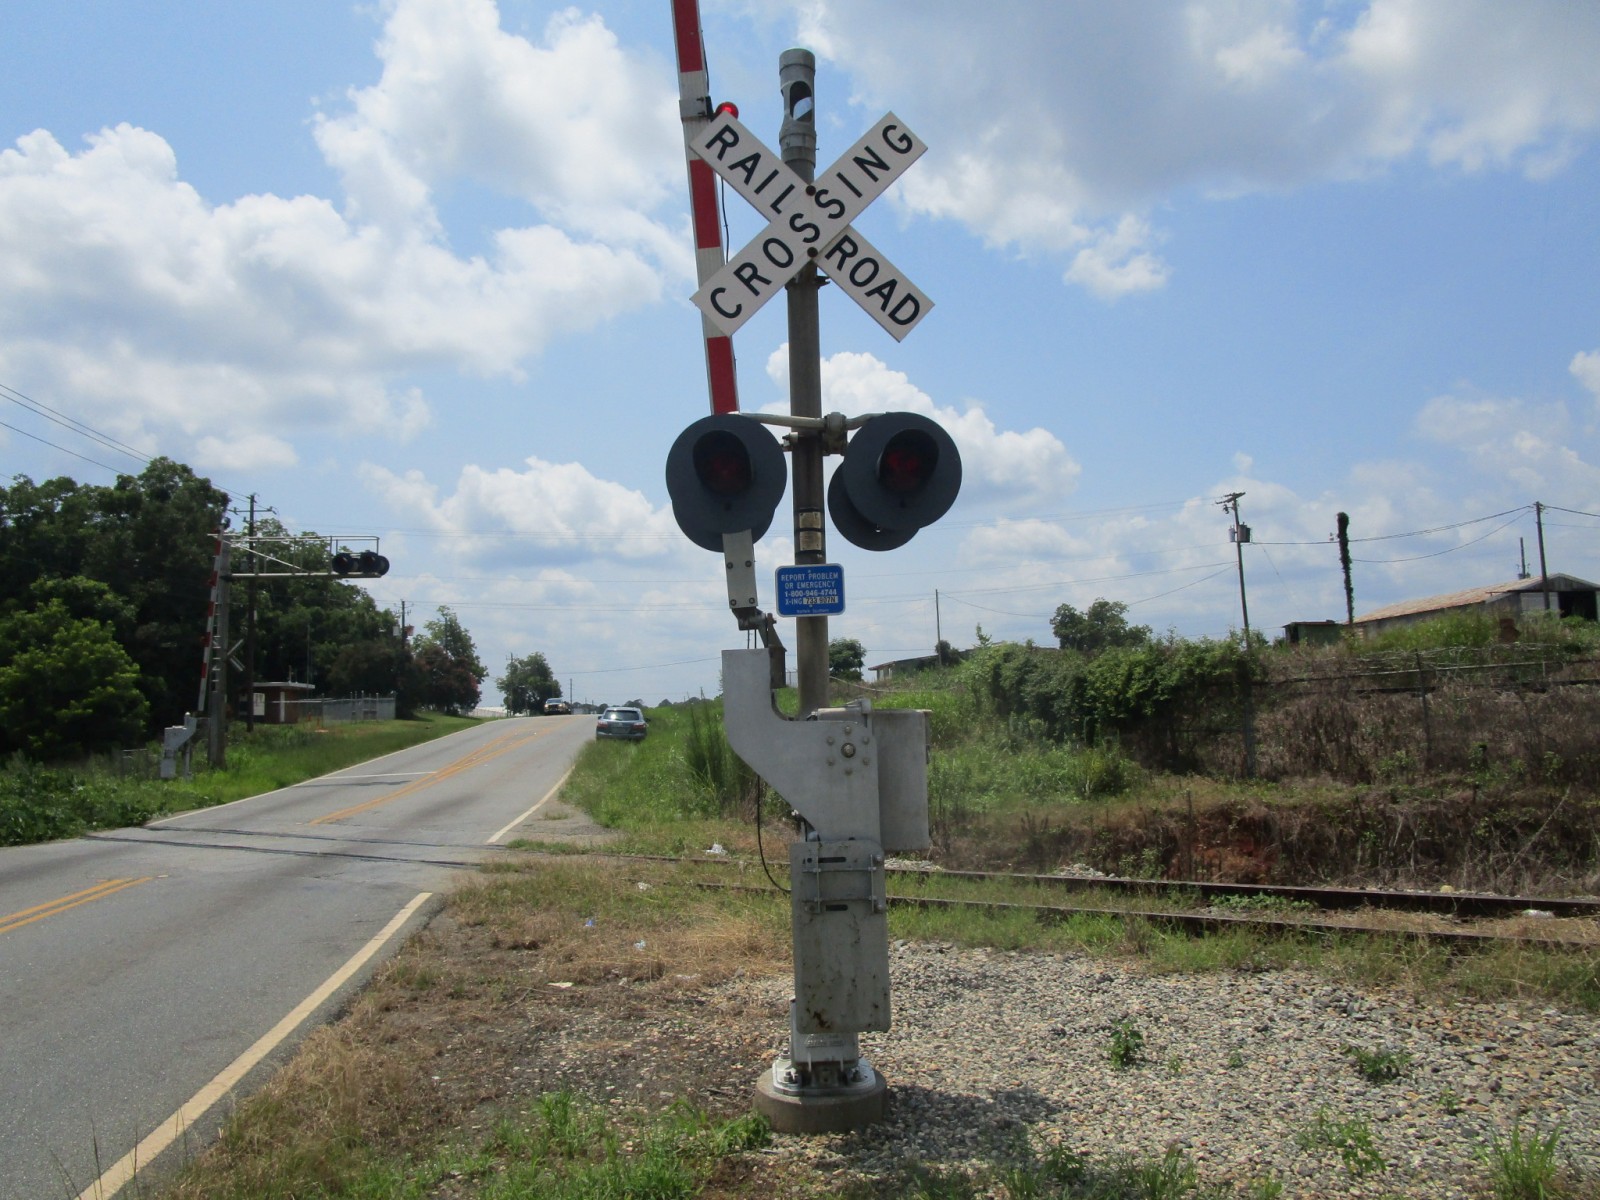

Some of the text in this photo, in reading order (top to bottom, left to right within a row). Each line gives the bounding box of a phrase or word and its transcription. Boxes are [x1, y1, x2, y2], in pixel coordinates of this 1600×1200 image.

[705, 124, 920, 326] RAIL ROAD
[710, 124, 913, 319] CROSSING
[781, 574, 805, 582] REPORT
[797, 581, 835, 589] EMERGENCY
